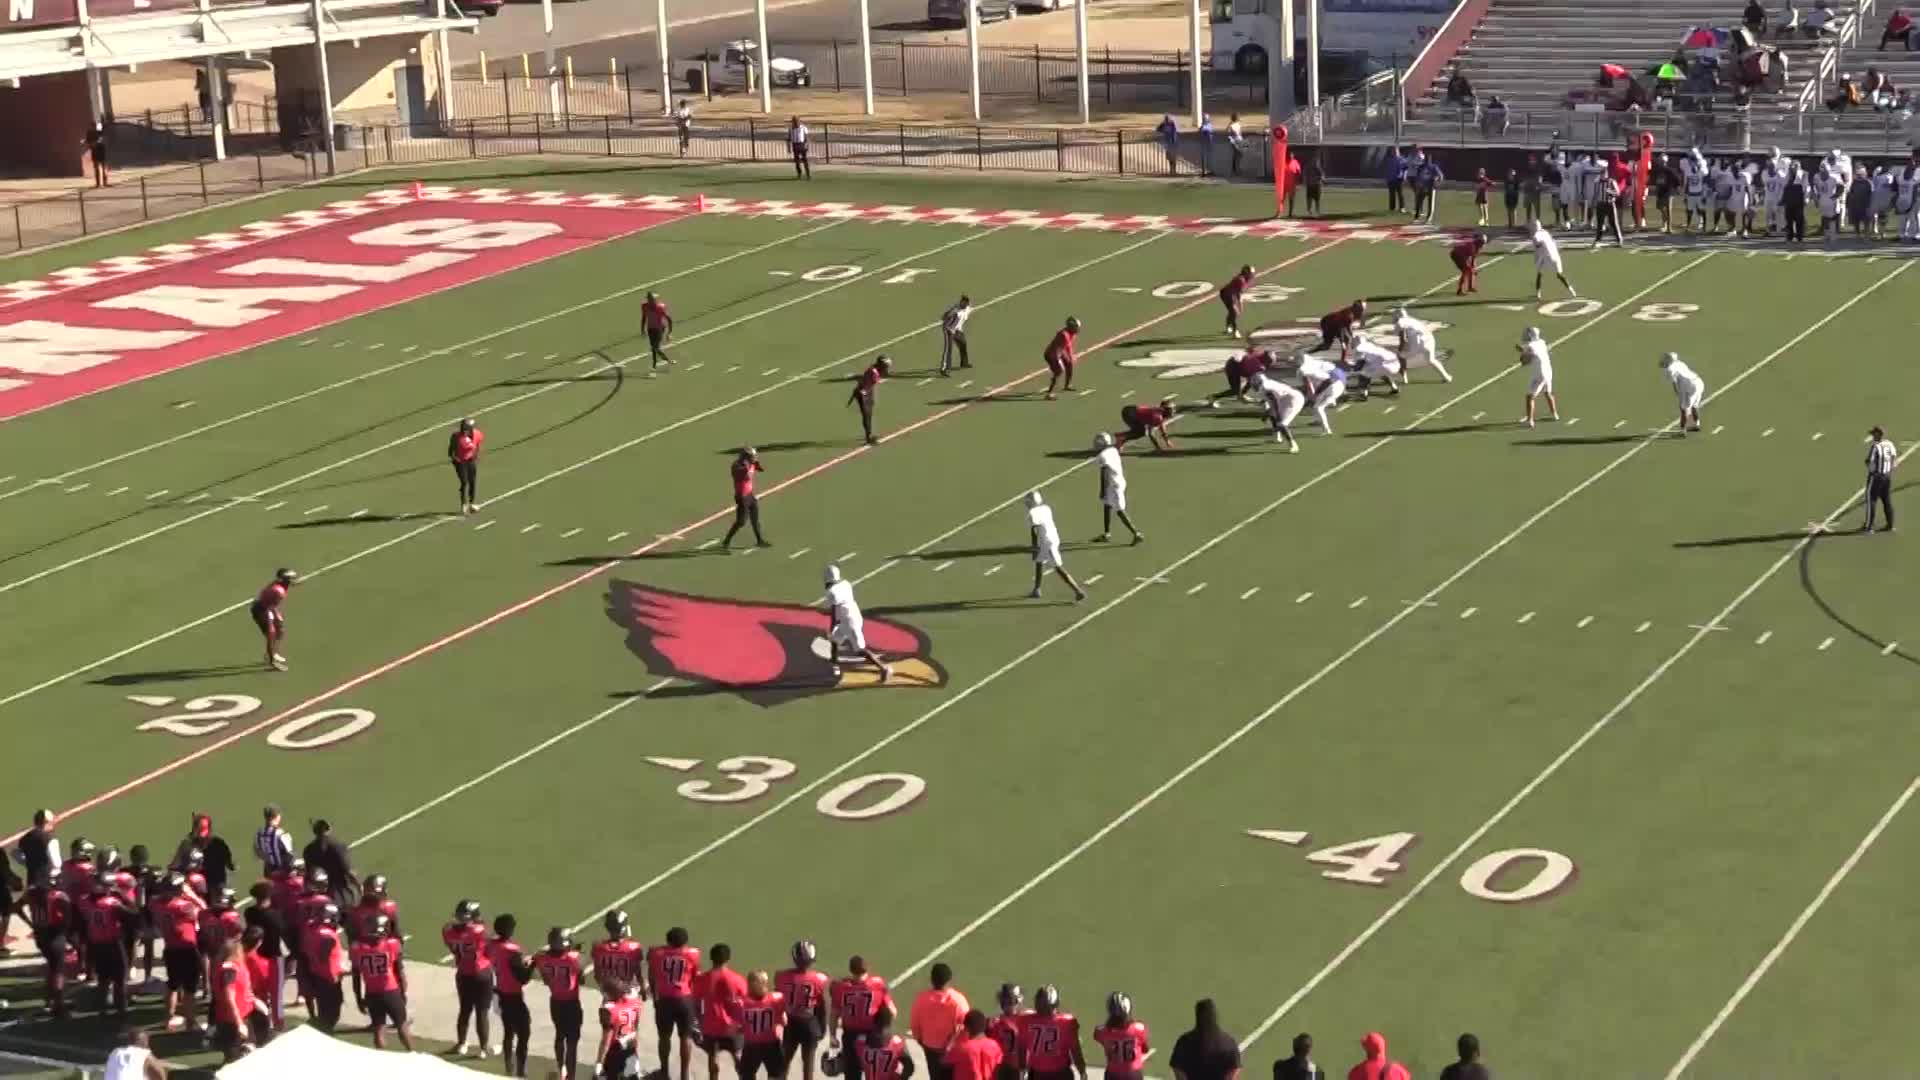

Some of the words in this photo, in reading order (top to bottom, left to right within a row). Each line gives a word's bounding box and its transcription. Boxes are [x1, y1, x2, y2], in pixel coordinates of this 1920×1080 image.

[0, 218, 563, 393] NALS
[136, 694, 376, 748] 20
[677, 756, 926, 818] 30
[1304, 831, 1574, 902] 40
